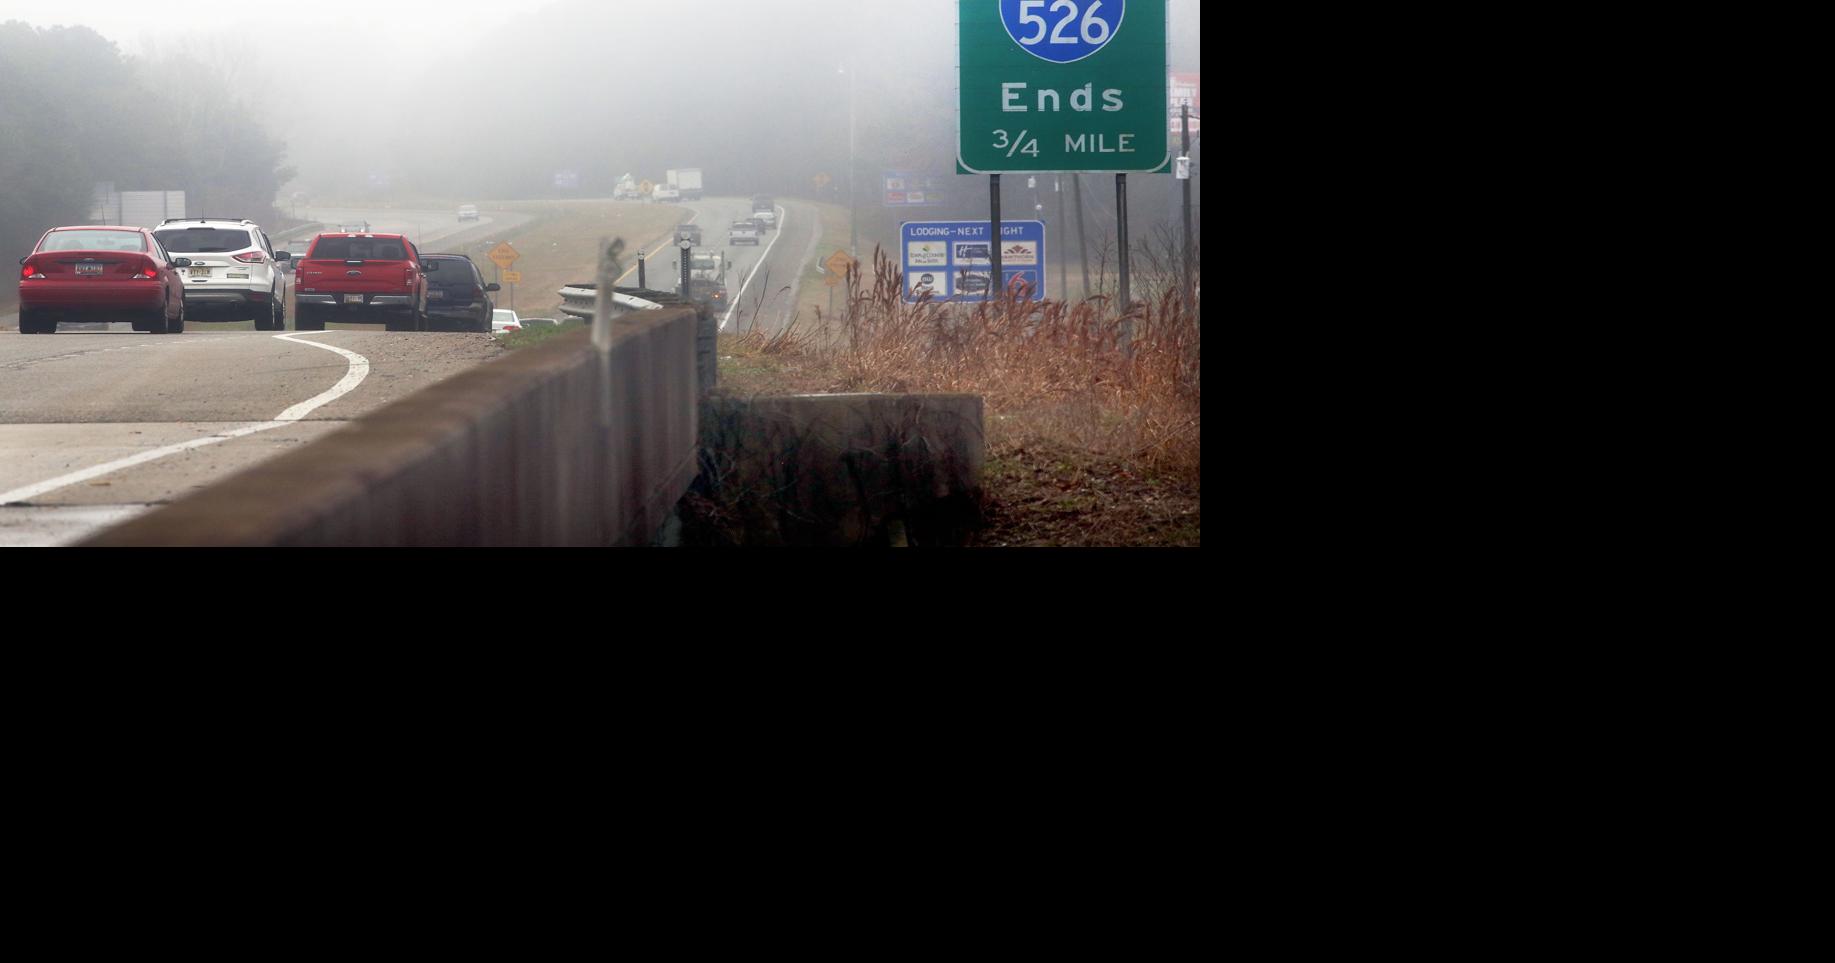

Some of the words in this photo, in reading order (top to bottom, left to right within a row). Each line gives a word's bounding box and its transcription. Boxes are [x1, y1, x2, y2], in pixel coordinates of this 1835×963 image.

[1018, 0, 1110, 46] 526
[1001, 82, 1124, 112] Ends
[992, 129, 1040, 158] 3/4
[1065, 134, 1136, 153] MILE
[1000, 226, 1024, 236] IGHT
